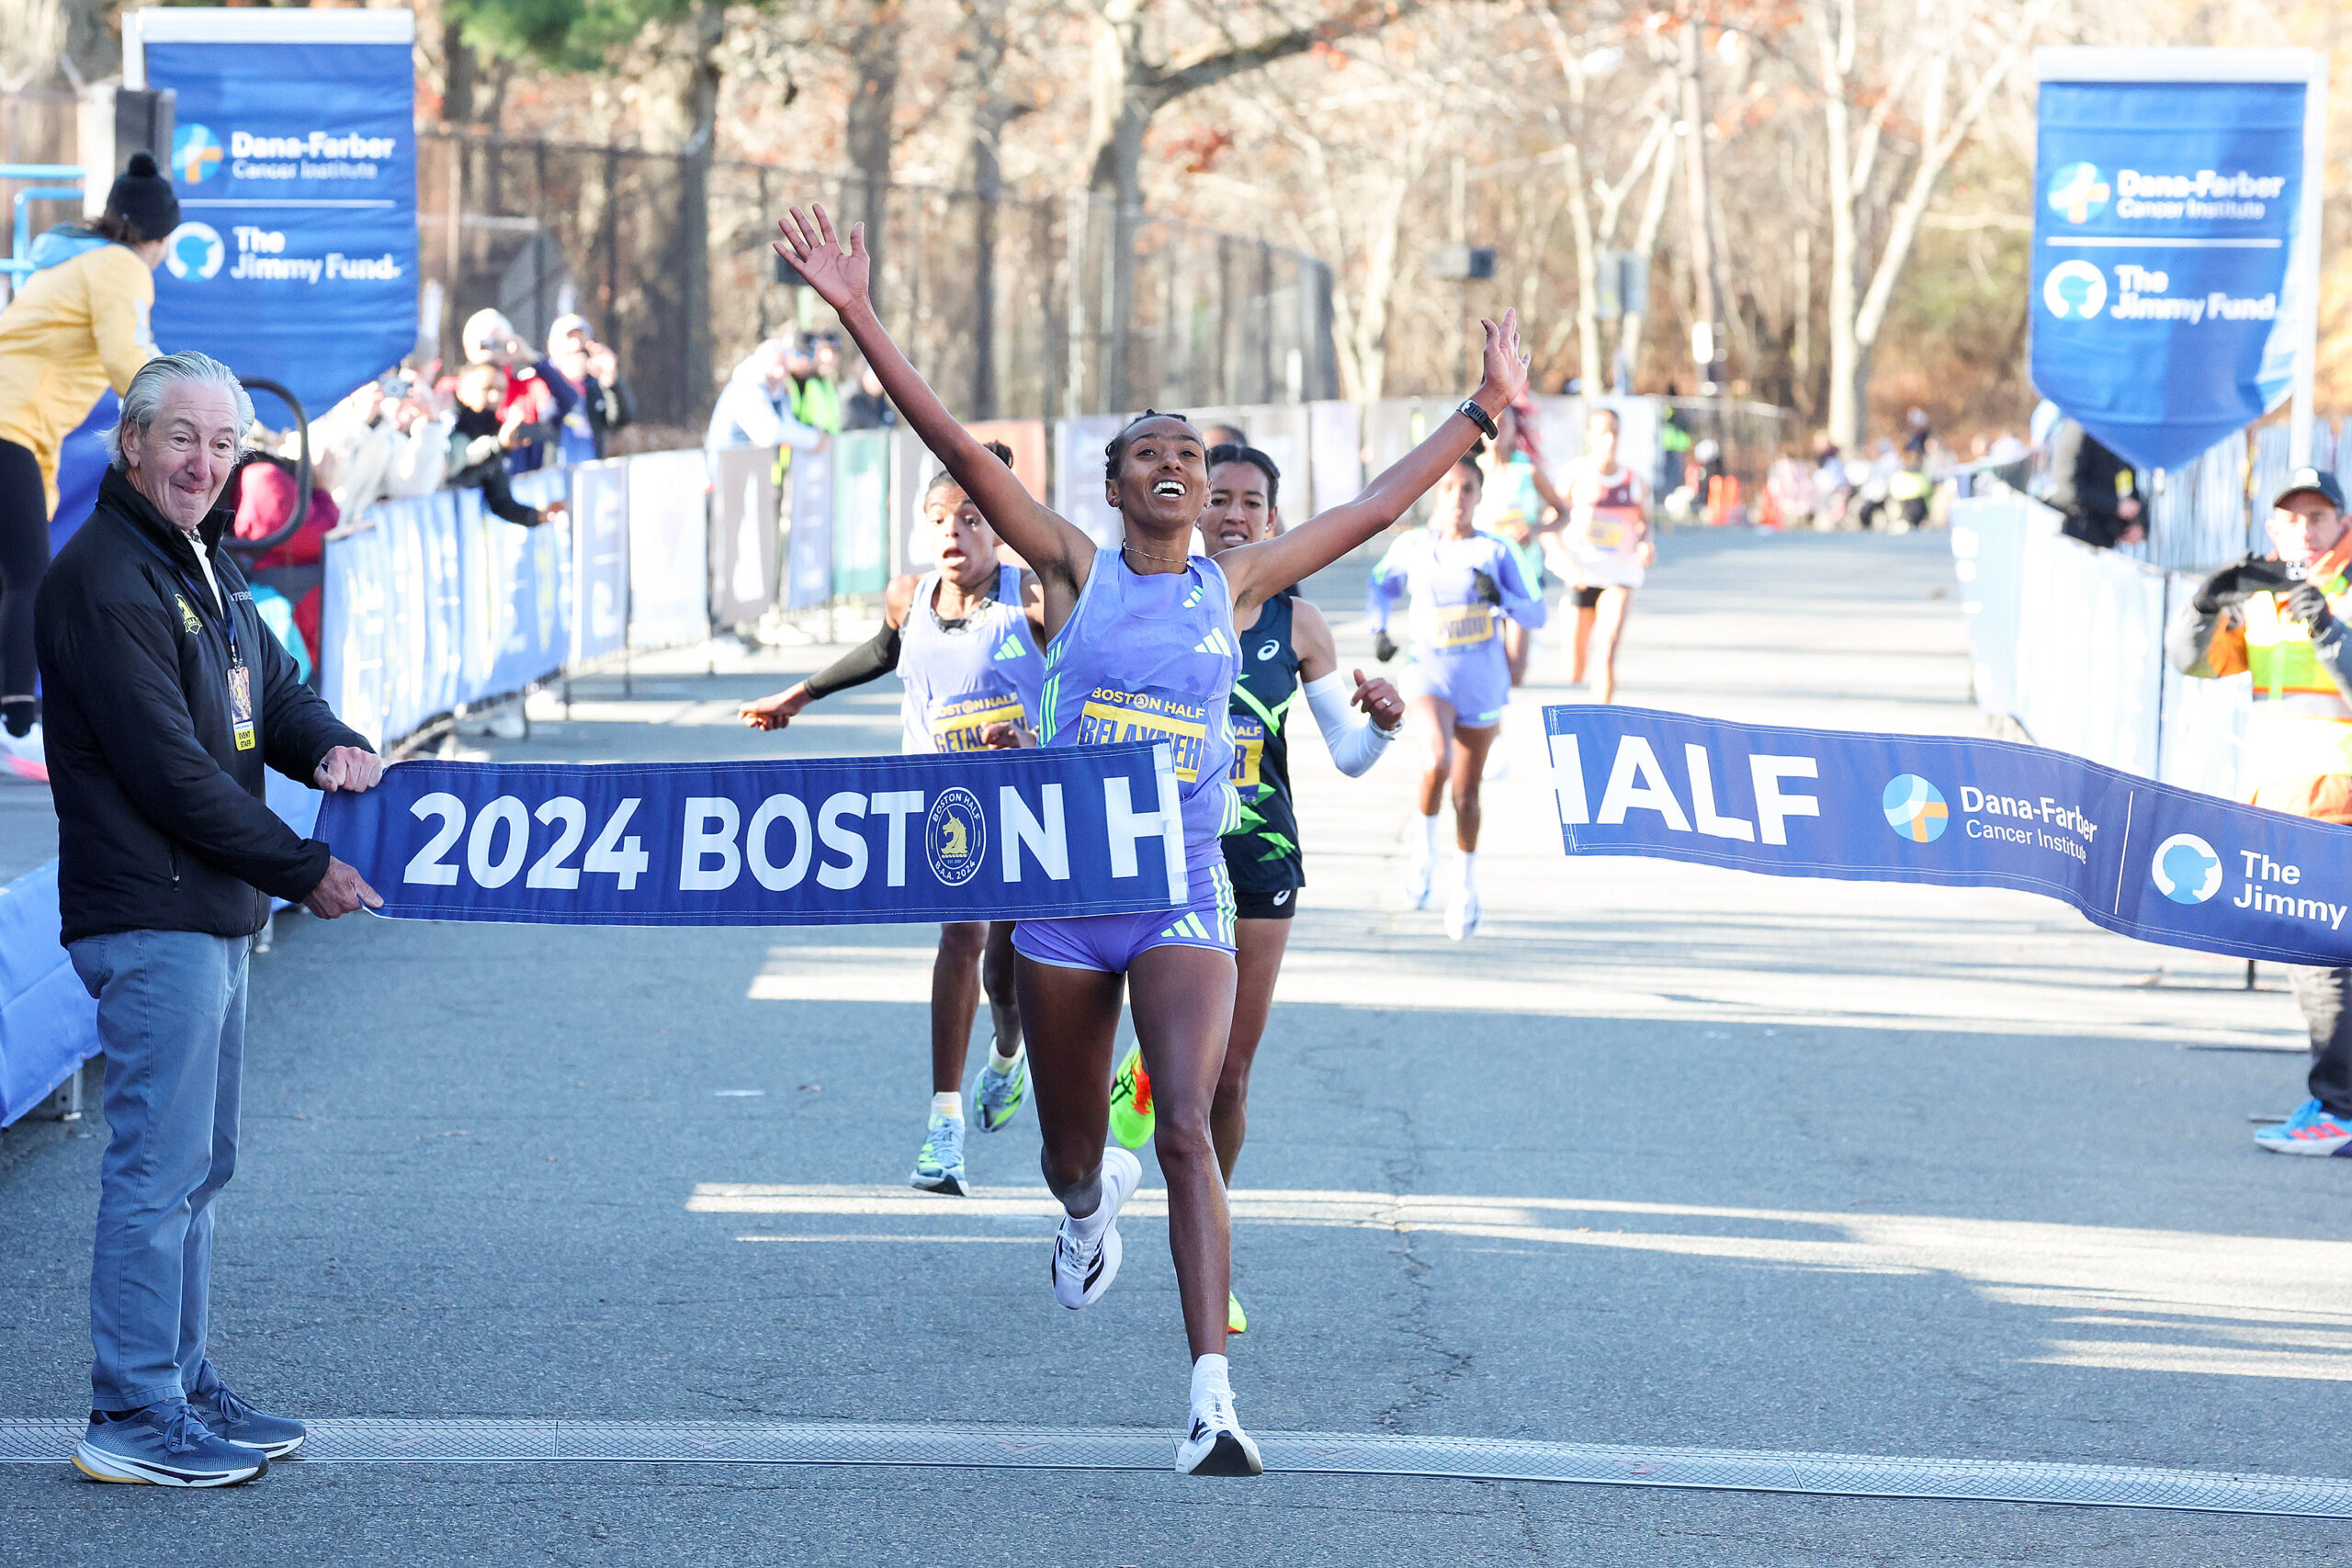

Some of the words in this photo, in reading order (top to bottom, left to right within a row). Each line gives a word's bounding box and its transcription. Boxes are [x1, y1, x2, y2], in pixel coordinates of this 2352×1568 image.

[232, 131, 396, 159] Dana-Farber
[232, 159, 298, 179] Cancer
[300, 159, 378, 179] Institute
[2117, 169, 2286, 198] Dana-Farber
[2116, 197, 2185, 219] Cancer
[2186, 197, 2266, 220] Institute
[232, 226, 286, 254] The
[230, 253, 323, 285] Jimmy
[2114, 265, 2169, 293] The
[2110, 292, 2206, 325] Jimmy
[986, 692, 1018, 710] HALF
[1091, 686, 1161, 711] BOSTON
[1164, 699, 1205, 719] HALF
[238, 730, 251, 740] EVENT
[240, 739, 252, 748] STAFF
[933, 793, 962, 822] BOSTON
[964, 795, 980, 820] HALF
[1960, 785, 2098, 843] Dana-Farber
[403, 792, 649, 891] 2024
[1965, 819, 2033, 845] Cancer
[2038, 828, 2086, 865] Institute
[935, 861, 955, 880] B.A.A.
[956, 860, 975, 879] 2024
[2240, 850, 2301, 885] The
[2233, 884, 2348, 931] Jimmy
